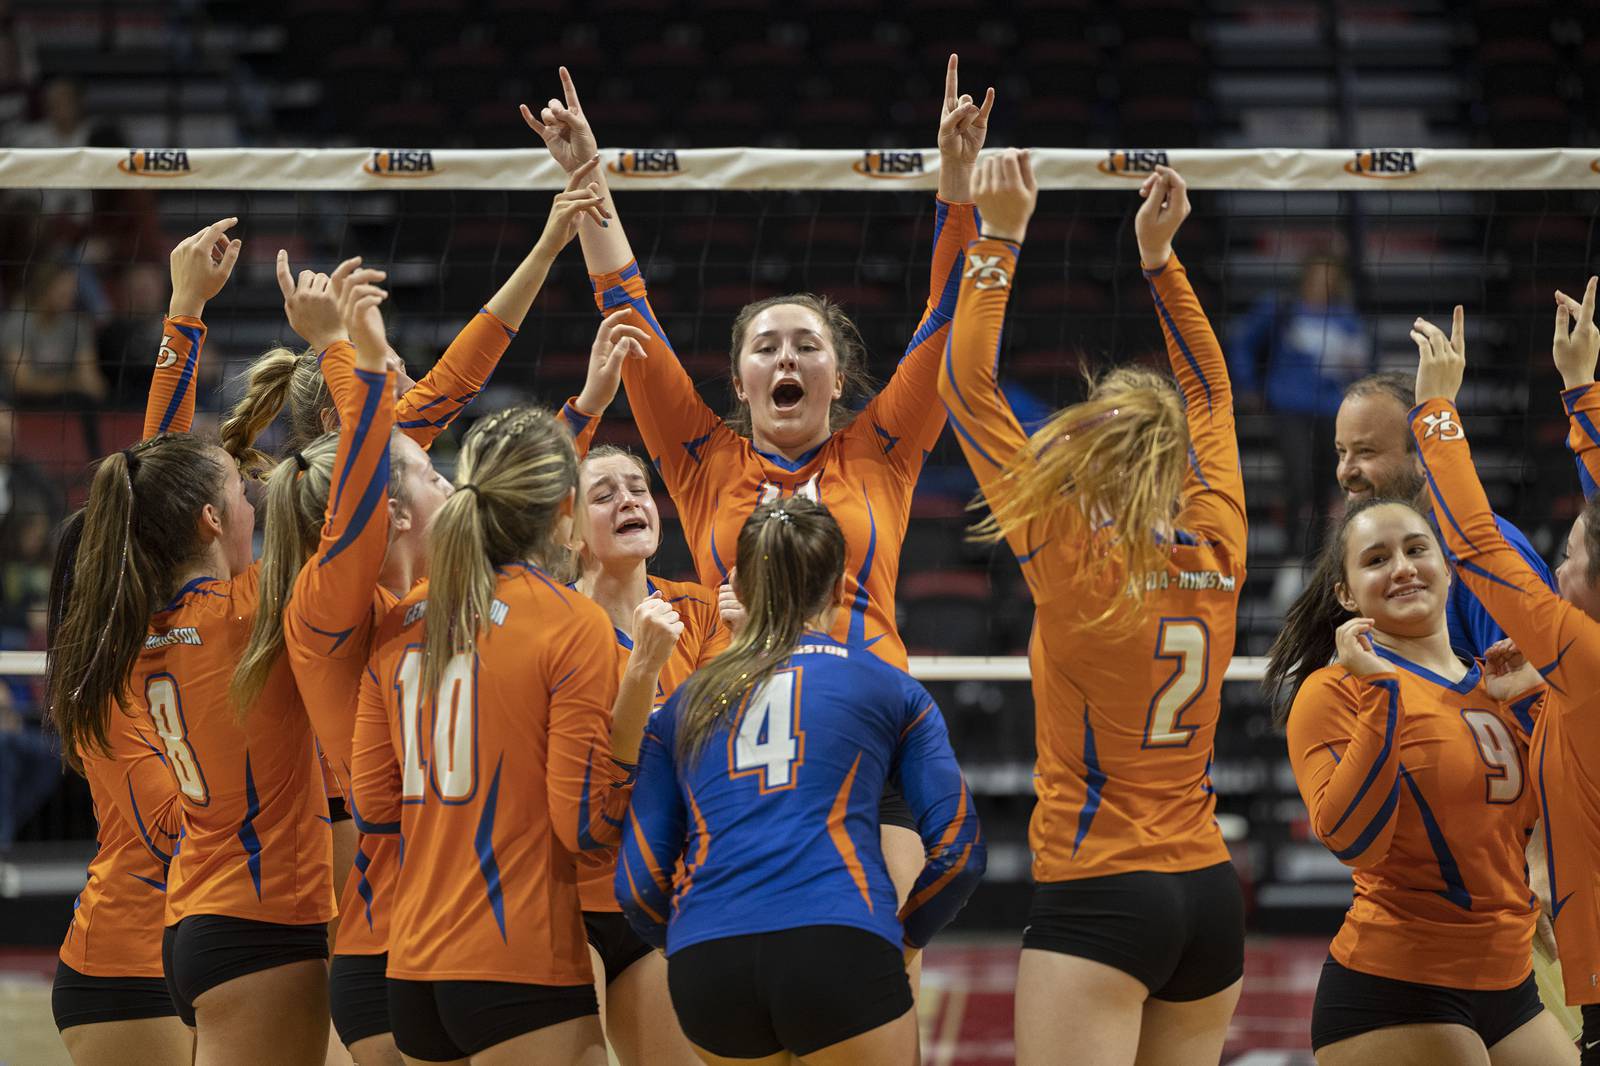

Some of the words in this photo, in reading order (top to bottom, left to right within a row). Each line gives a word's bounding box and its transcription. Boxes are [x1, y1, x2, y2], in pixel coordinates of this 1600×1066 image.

[145, 672, 209, 807] 8
[394, 643, 478, 805] 10
[730, 666, 804, 795] 4
[1141, 616, 1210, 750] 2
[1459, 708, 1524, 804] 9
